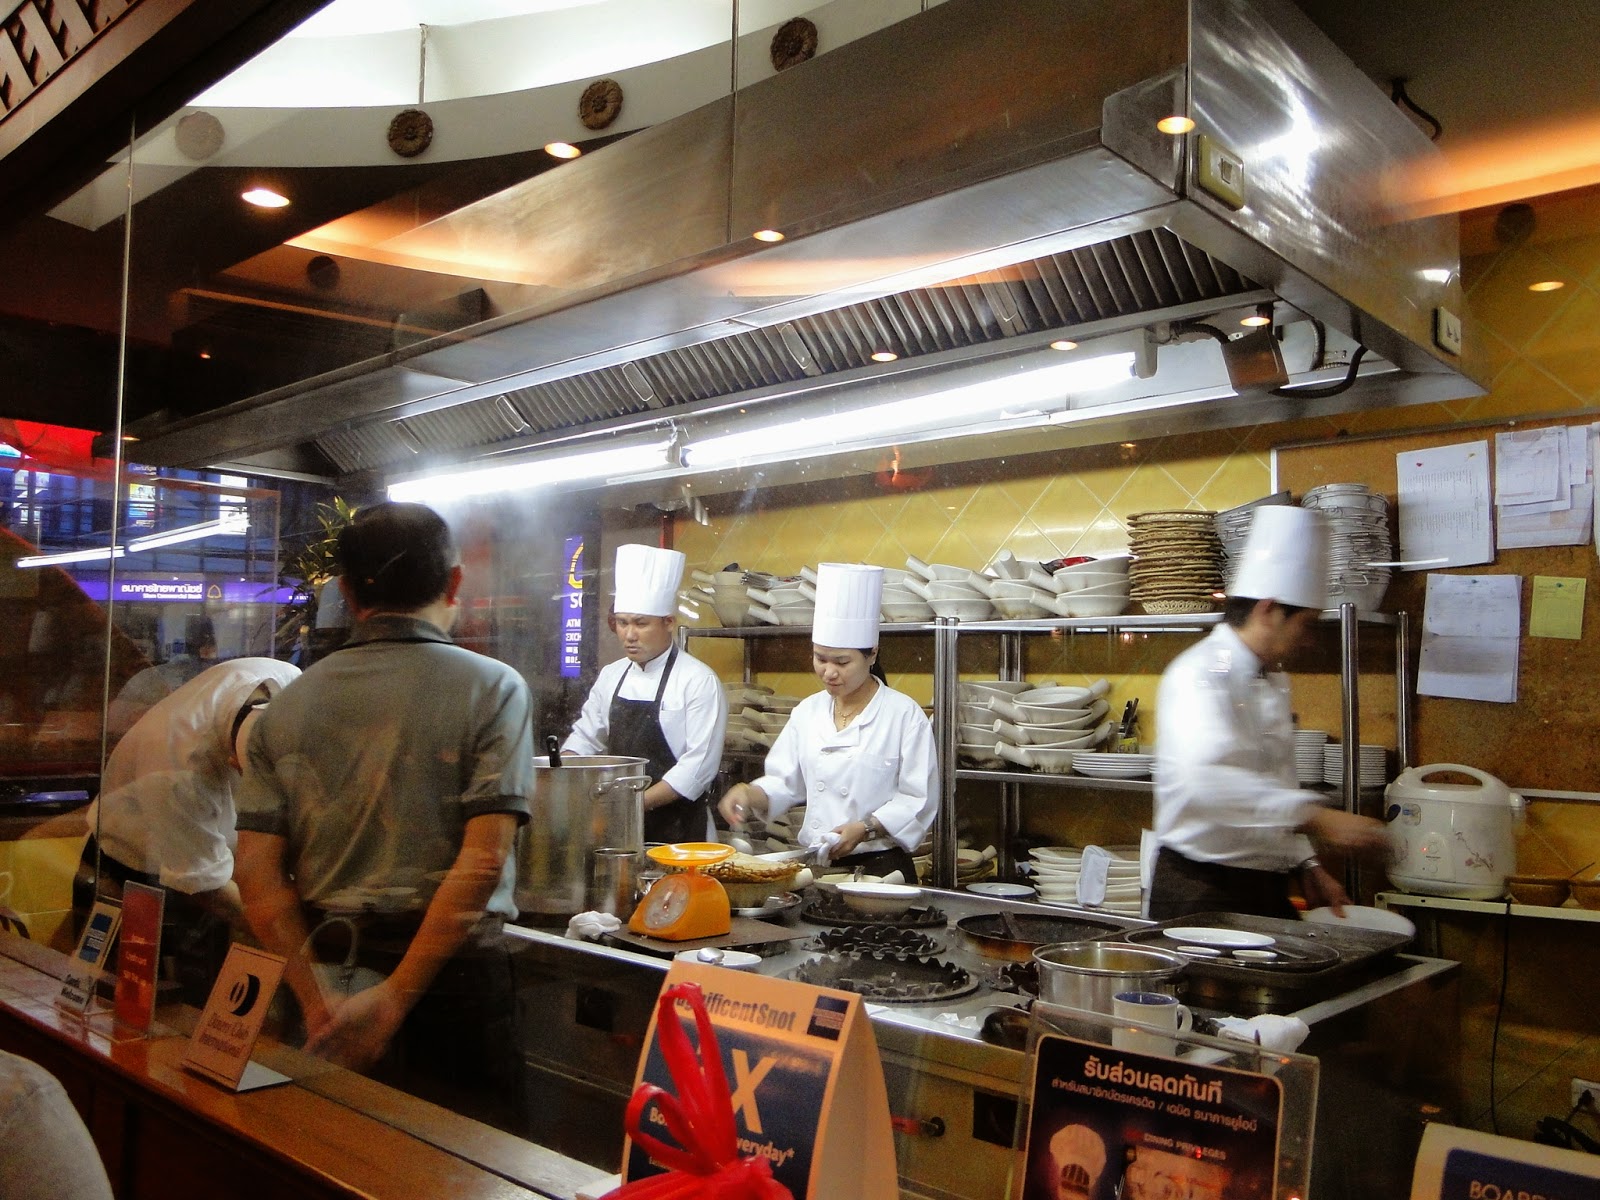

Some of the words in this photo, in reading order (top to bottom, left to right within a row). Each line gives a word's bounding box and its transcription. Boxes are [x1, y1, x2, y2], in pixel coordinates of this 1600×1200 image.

[1083, 1055, 1223, 1104] รับส่วนลดทันที
